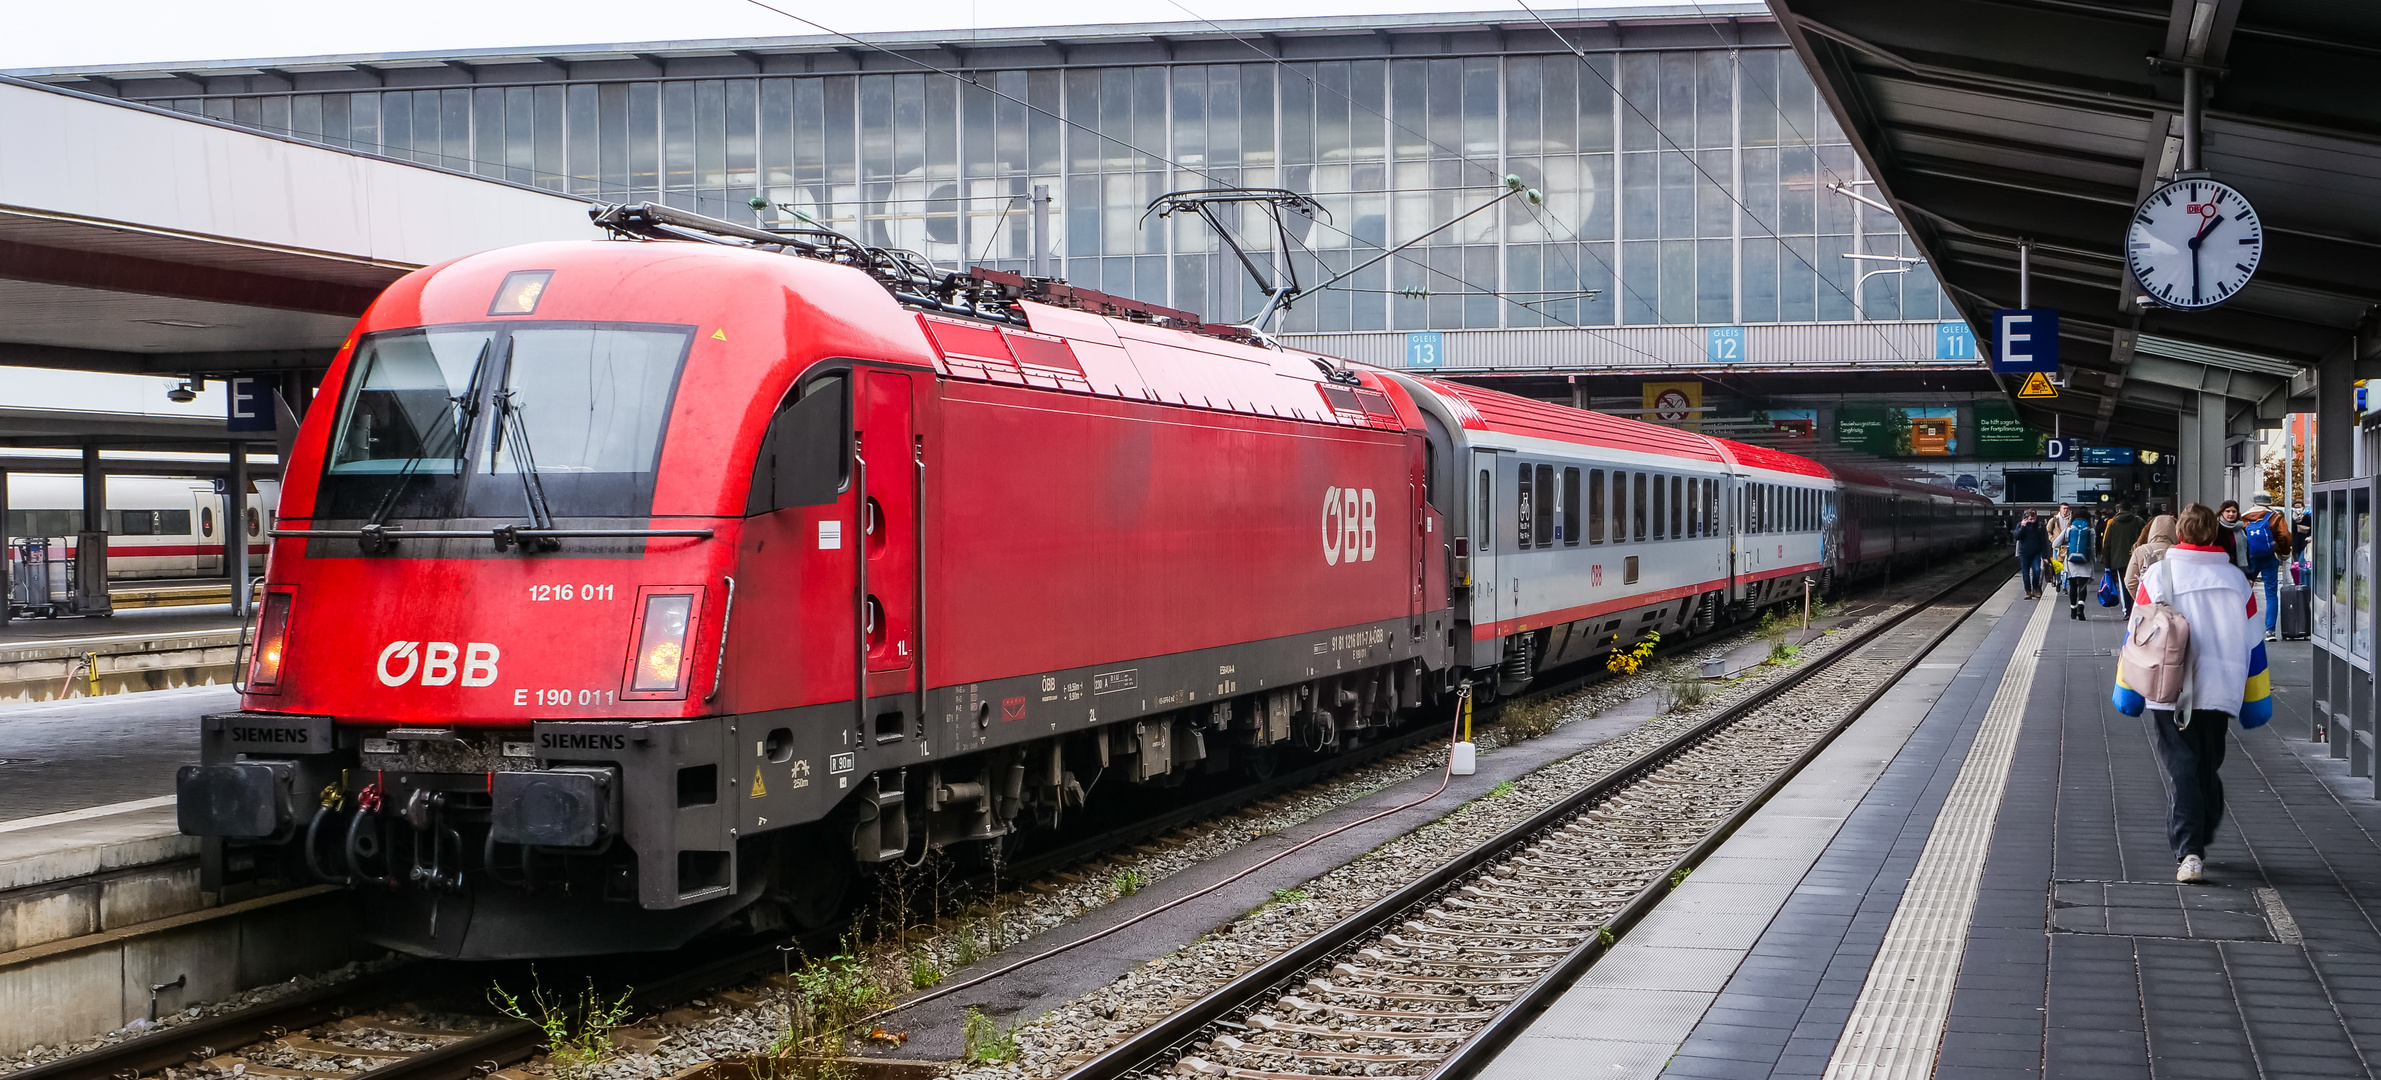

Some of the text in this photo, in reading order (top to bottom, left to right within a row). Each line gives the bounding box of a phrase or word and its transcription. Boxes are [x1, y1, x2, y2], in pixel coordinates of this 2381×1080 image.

[2187, 204, 2201, 214] DB
[1947, 335, 1963, 356] 11
[2002, 315, 2032, 361] E
[1414, 343, 1435, 364] 13
[1714, 338, 1737, 359] 12
[233, 378, 255, 418] E
[2048, 440, 2063, 458] D
[216, 478, 225, 491] D
[2153, 473, 2160, 483] C
[1556, 472, 1561, 512] 2
[154, 511, 159, 520] 2
[1322, 486, 1376, 566] ÖBB
[1591, 565, 1602, 587] ÖBB
[529, 584, 614, 601] 1216 011
[897, 640, 908, 656] 1L
[1331, 636, 1337, 651] 91
[1345, 633, 1355, 648] 1216
[377, 641, 500, 687] ÖBB
[1042, 675, 1055, 692] ÖBB
[513, 689, 614, 706] E 190 011
[1089, 708, 1097, 722] 2L
[232, 727, 308, 743] SIEMENS
[540, 733, 625, 750] SIEMENS
[920, 740, 930, 756] 1L
[832, 756, 852, 771] R 90m
[793, 777, 809, 789] 250m
